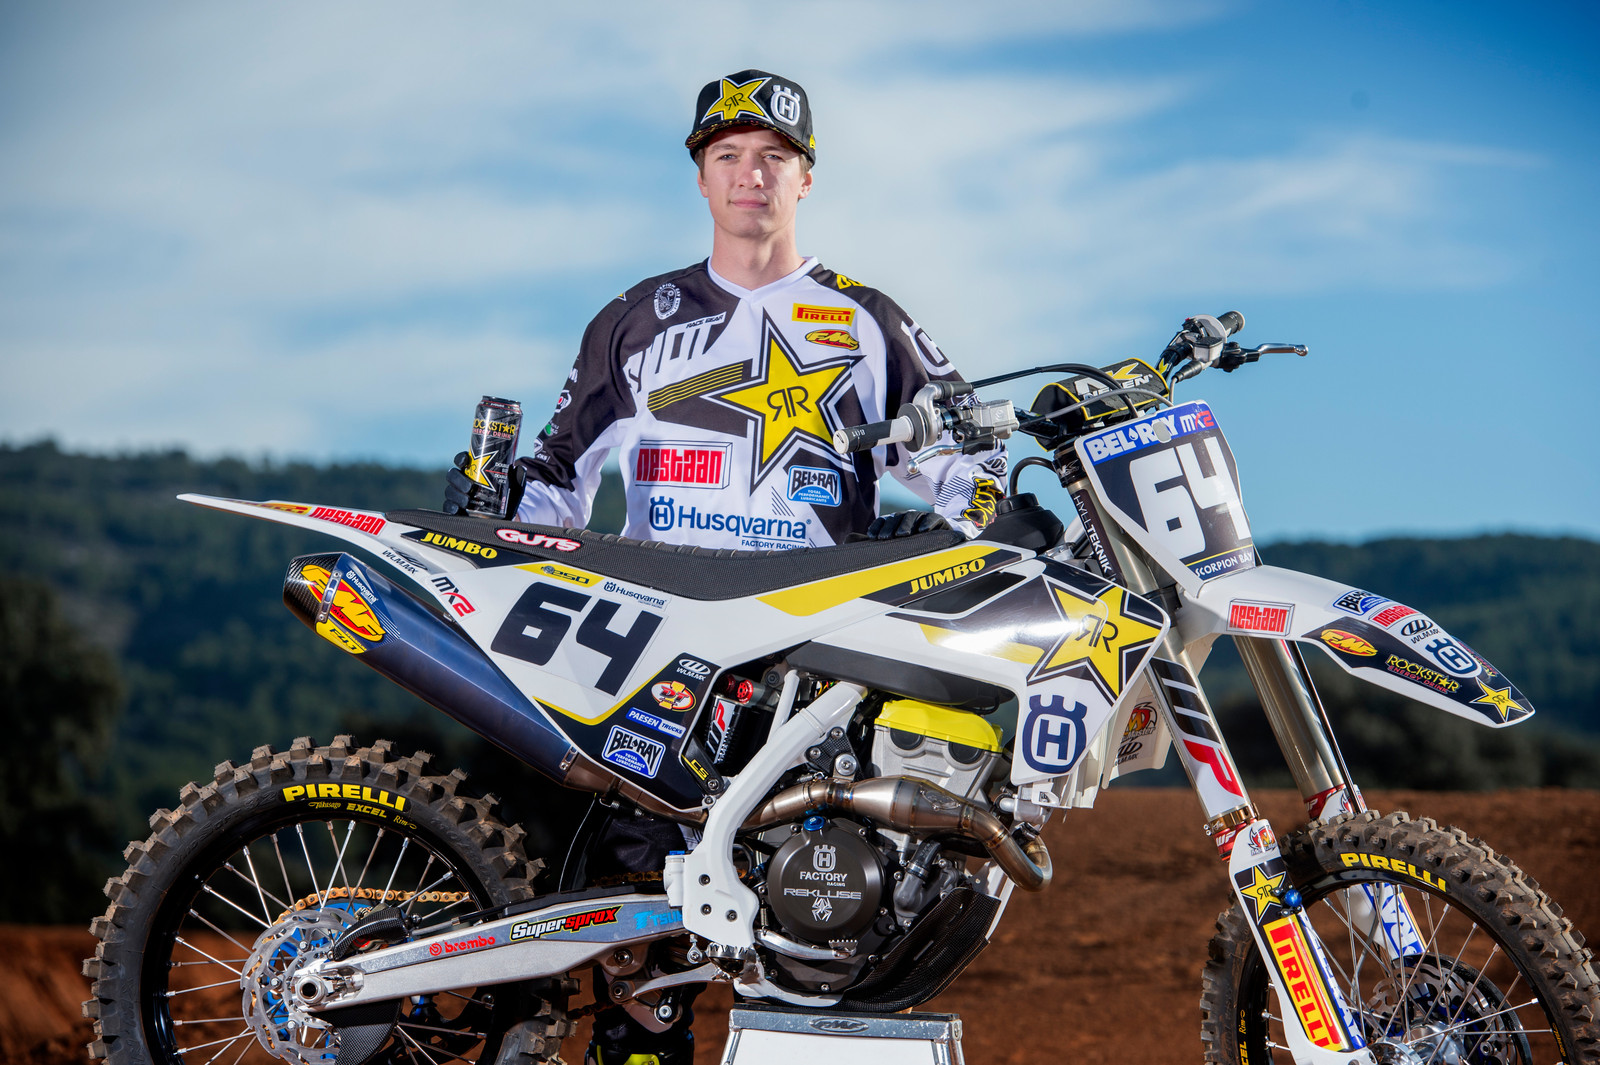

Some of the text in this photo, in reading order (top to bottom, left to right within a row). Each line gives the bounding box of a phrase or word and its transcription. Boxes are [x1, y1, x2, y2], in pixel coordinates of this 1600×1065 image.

[797, 307, 851, 322] PIRELLI
[1083, 374, 1153, 400] NEEN
[1129, 436, 1252, 561] 64
[678, 505, 807, 539] Husqvarna
[420, 532, 498, 560] JUMBO
[496, 528, 583, 552] GUTS
[741, 539, 775, 549] FACTORY
[909, 558, 986, 595] JUMBO
[1195, 550, 1253, 579] SCORPION BAY
[615, 587, 667, 606] Husqvarna
[490, 581, 664, 697] 64
[1388, 665, 1448, 693] ENERGY DRINK
[628, 710, 683, 734] PAESEN TRUCKS
[282, 783, 406, 811] PIRELLI
[346, 802, 387, 818] EXCEL
[393, 815, 417, 830] Rim
[799, 871, 848, 882] FACTORY
[1340, 852, 1447, 892] PIRELLI
[783, 887, 862, 900] REKLUSE
[511, 907, 618, 938] Supersprox
[444, 935, 496, 953] brembo
[1269, 922, 1342, 1049] PIRELLI
